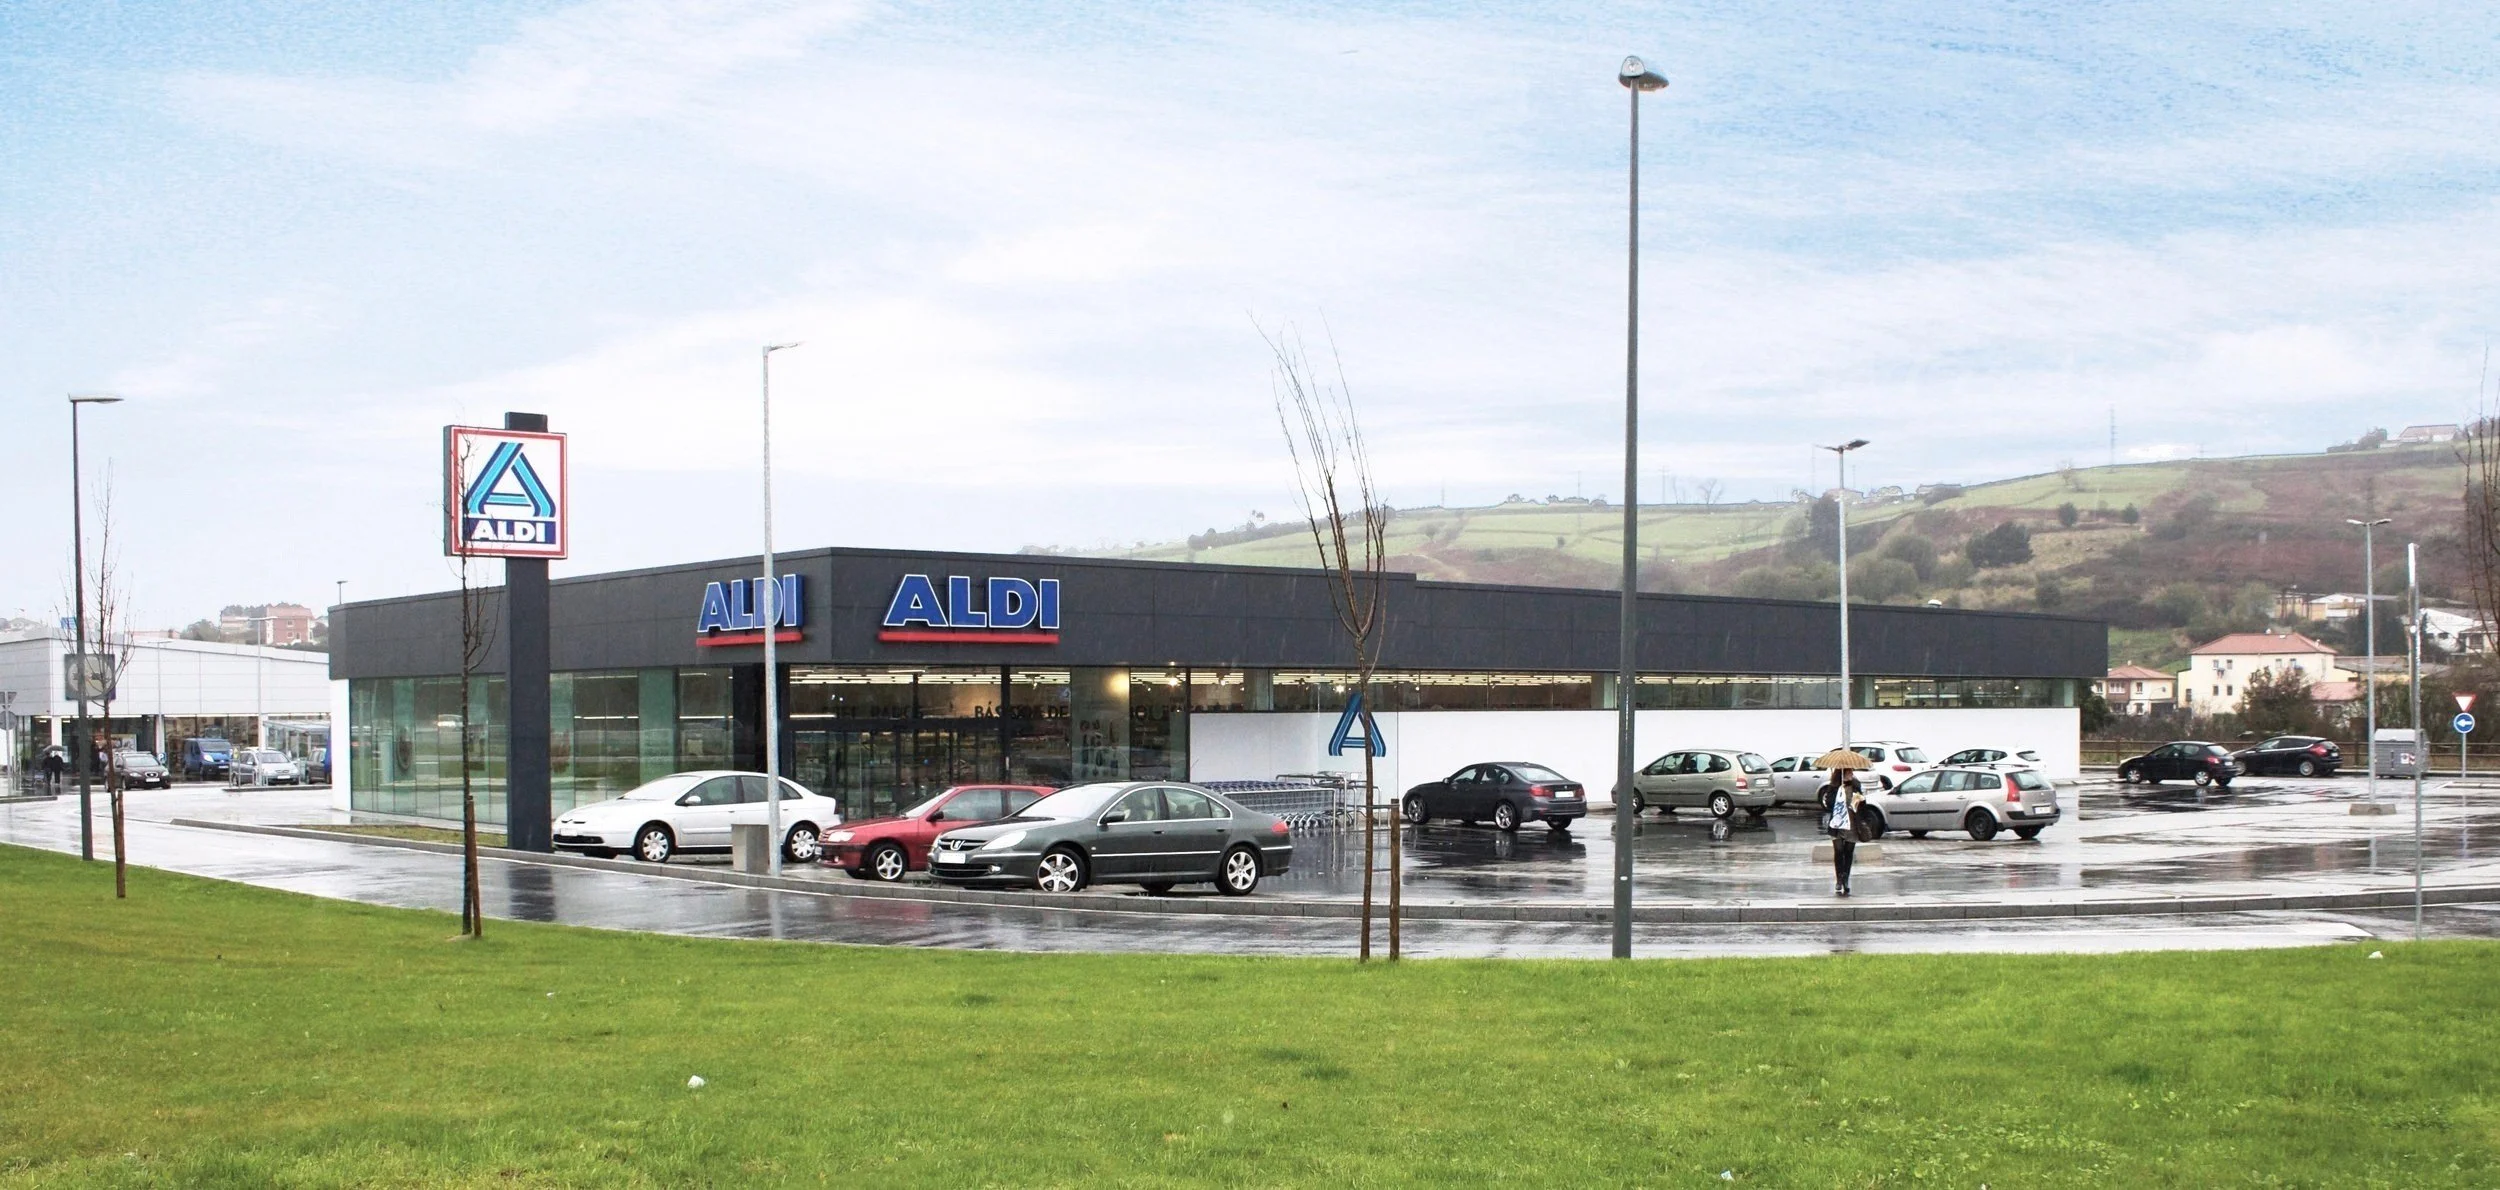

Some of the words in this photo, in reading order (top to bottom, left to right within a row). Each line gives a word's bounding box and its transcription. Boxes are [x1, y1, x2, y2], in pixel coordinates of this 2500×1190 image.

[471, 519, 546, 543] ALDI
[697, 573, 802, 633] ALDI
[882, 573, 1060, 629] ALDI
